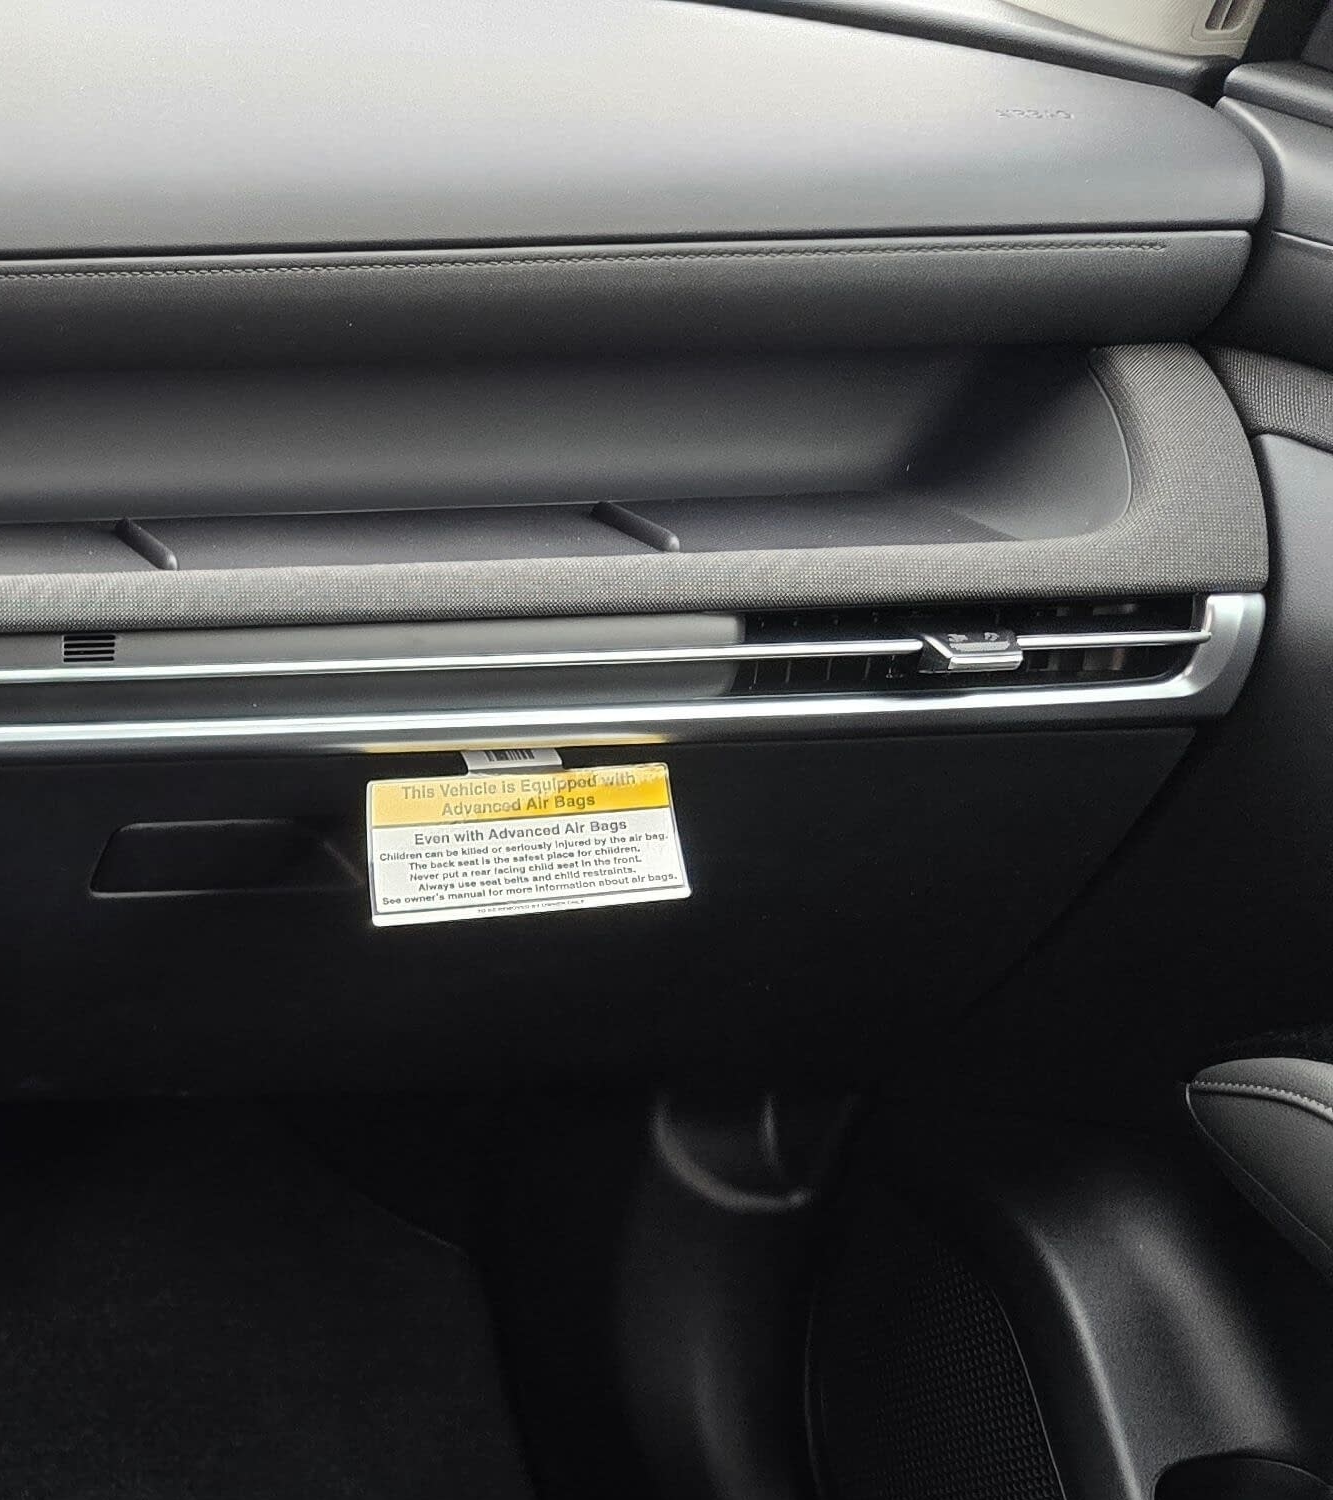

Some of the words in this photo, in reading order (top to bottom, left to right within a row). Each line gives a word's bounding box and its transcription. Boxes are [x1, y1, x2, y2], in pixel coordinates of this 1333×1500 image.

[402, 786, 435, 799] This
[440, 782, 496, 798] Vehicle
[502, 781, 515, 794] is
[521, 774, 597, 794] Equipped
[602, 772, 636, 786] with
[442, 798, 521, 816] Advanced
[527, 798, 549, 810] Air
[555, 795, 596, 810] Bags
[414, 834, 450, 845] Even
[454, 830, 484, 842] with
[488, 824, 560, 840] Advanced
[565, 822, 586, 835] Air
[590, 821, 627, 833] Bags
[379, 850, 422, 862] Children
[425, 852, 443, 860] can
[446, 849, 459, 858] be
[461, 847, 489, 856] killed
[505, 842, 552, 853] seriously
[555, 838, 591, 850] injured
[594, 838, 607, 847] by
[610, 835, 626, 844] the
[629, 834, 642, 842] air
[645, 832, 668, 842] bag.
[409, 862, 427, 871] The
[431, 860, 455, 869] back
[458, 859, 479, 867] seat
[482, 857, 491, 865] is
[494, 856, 510, 864] the
[513, 852, 545, 862] safest
[547, 851, 575, 862] place
[577, 849, 592, 857] for
[594, 845, 641, 856] children.
[409, 873, 439, 882] Never
[442, 871, 460, 881] put
[471, 869, 491, 877] rear
[494, 865, 526, 875] facing
[528, 861, 554, 872] child
[557, 861, 579, 870] seat
[581, 859, 592, 867] in
[594, 858, 611, 866] the
[418, 883, 455, 892] Always
[458, 881, 477, 889] use
[479, 878, 502, 887] seat
[504, 875, 530, 885] belts
[532, 873, 552, 882] and
[554, 870, 581, 880] child
[382, 897, 401, 905] See
[404, 893, 445, 903] owner's
[448, 890, 486, 900] manual
[488, 888, 503, 897] for
[506, 886, 533, 896] more
[535, 881, 596, 892] information
[598, 877, 630, 887] about
[631, 874, 646, 883] air
